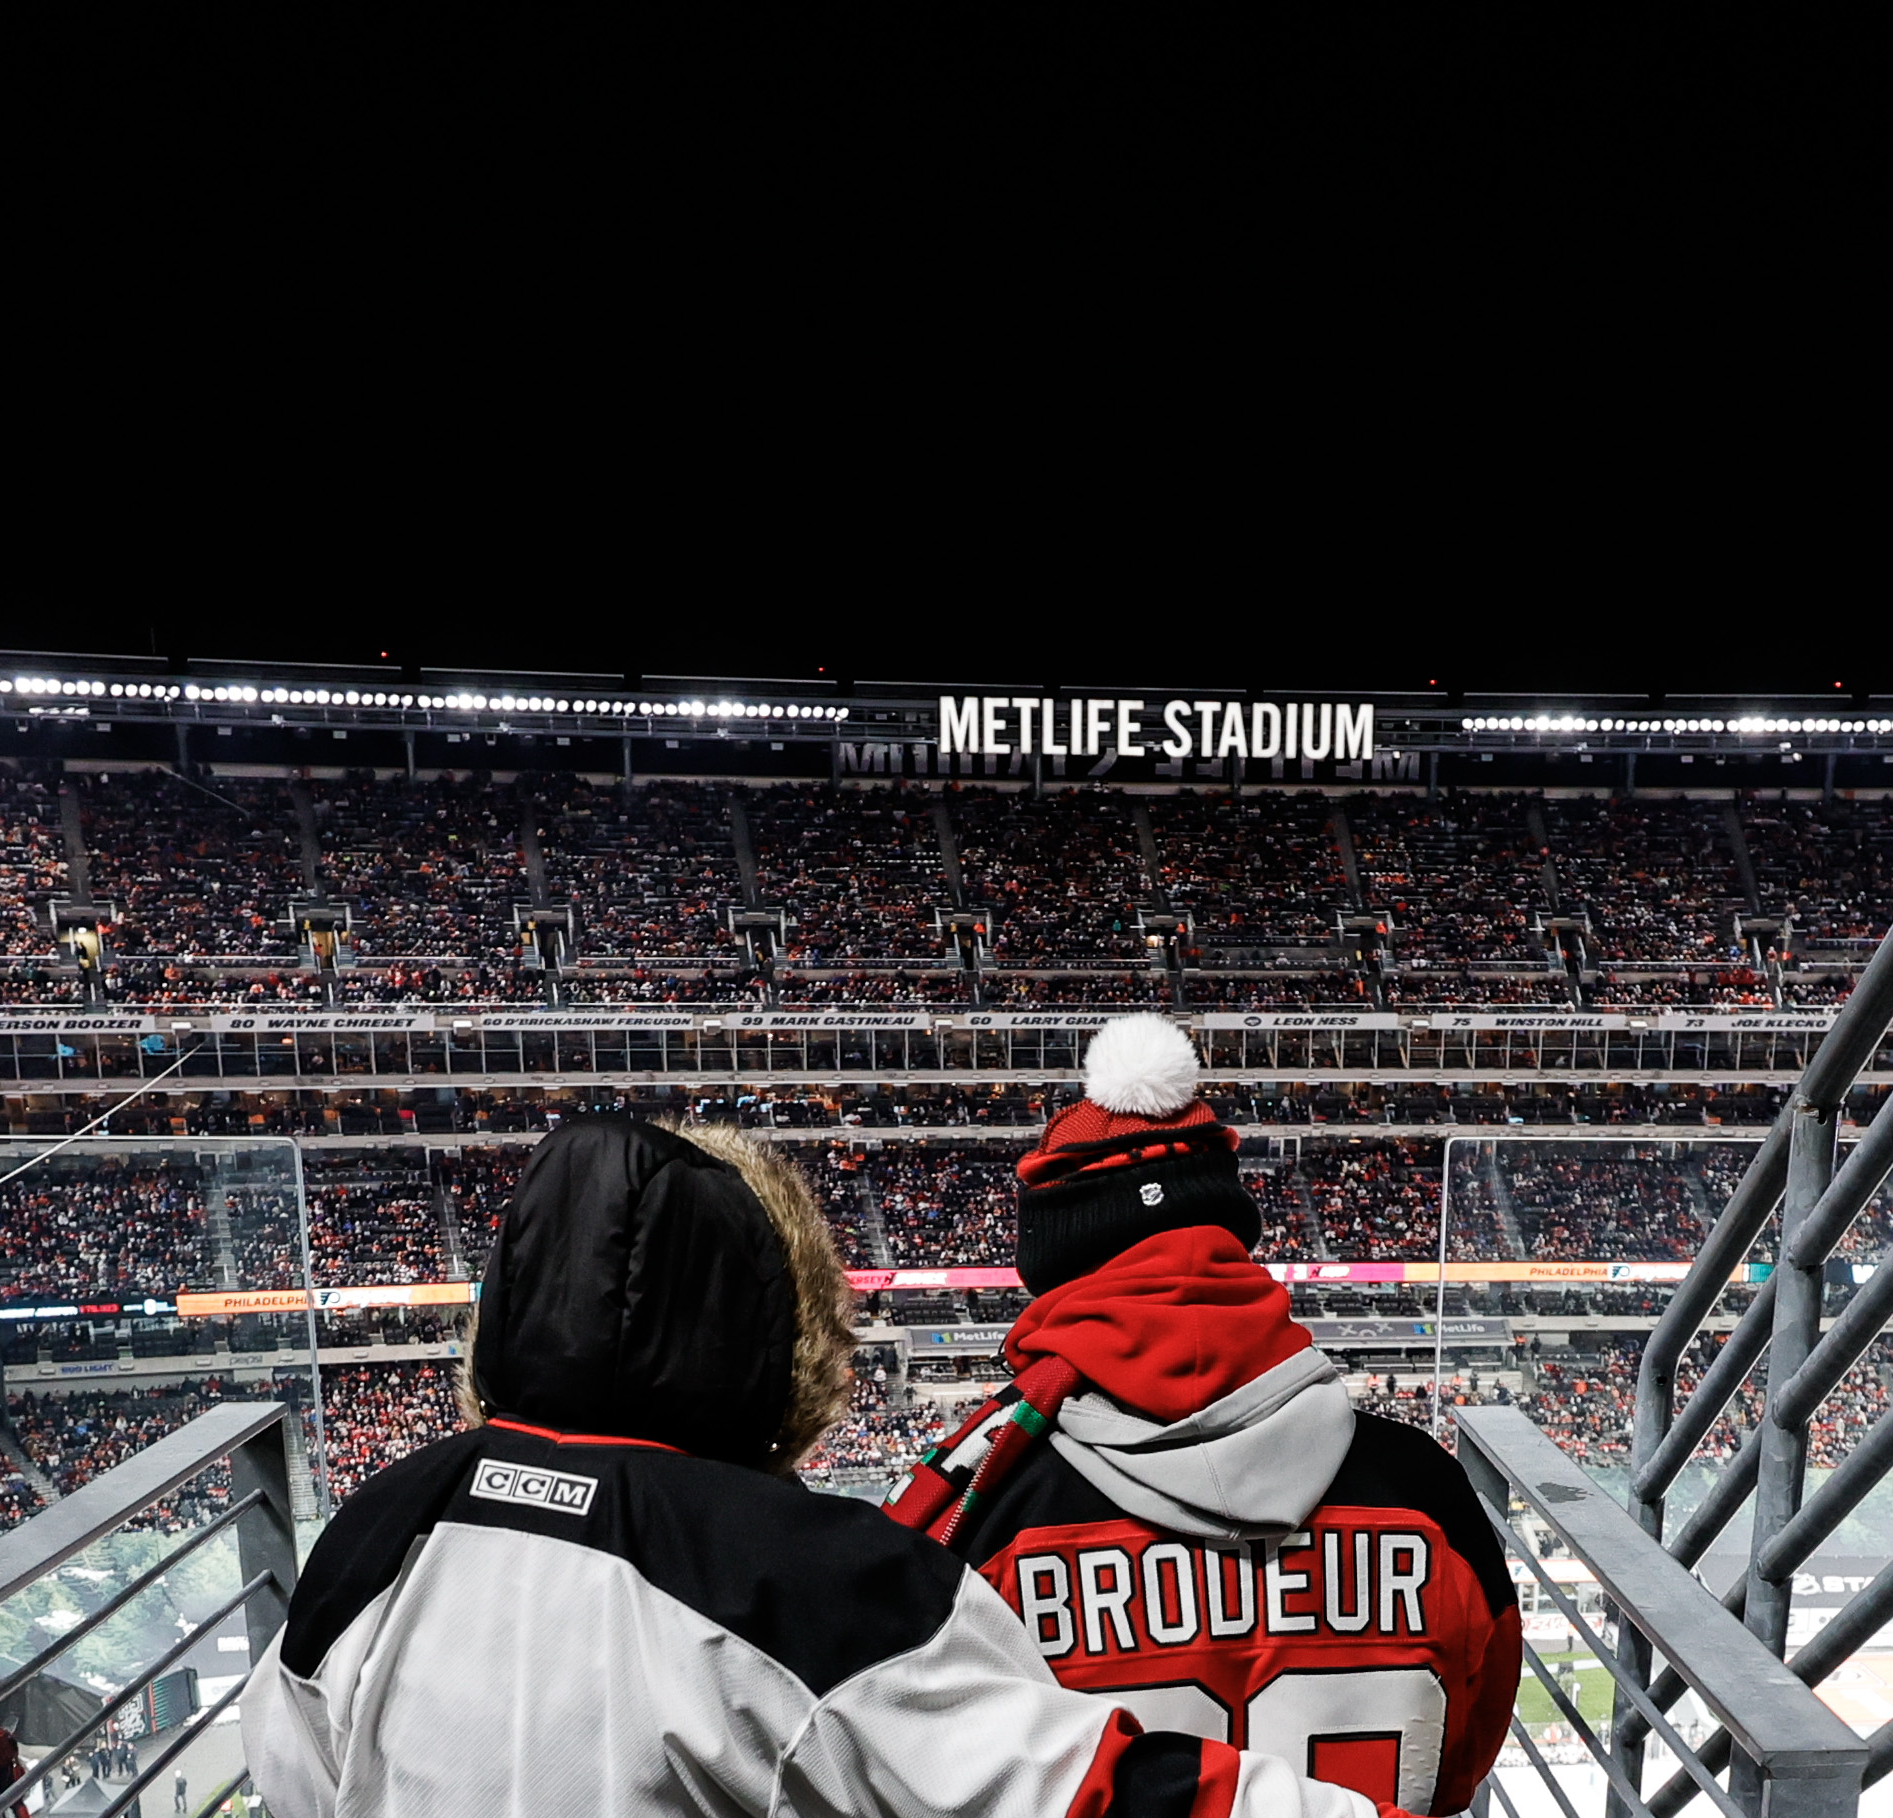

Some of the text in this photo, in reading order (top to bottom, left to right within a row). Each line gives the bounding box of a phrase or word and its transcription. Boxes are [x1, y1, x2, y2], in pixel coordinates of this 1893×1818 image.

[938, 696, 1376, 761] METLIFE STADIUM
[63, 1019, 143, 1030] BOOZER
[229, 1018, 418, 1029] 80 WAYNE CHREBET
[504, 1017, 616, 1027] D'BRICKASHAW
[616, 1016, 693, 1026] FERGUSON
[741, 1016, 917, 1026] 99 MARK GASTINEAU
[1010, 1016, 1064, 1026] LARRY
[1272, 1017, 1359, 1027] LEON HESS
[1451, 1017, 1605, 1027] 75 WINSTON HILL
[1684, 1018, 1829, 1028] 73 JOE KLECKO
[1529, 1267, 1607, 1277] PHILADELPHIA
[953, 1330, 1006, 1342] MetLife
[485, 1471, 588, 1506] CCM
[1015, 1529, 1429, 1660] BRODEUR
